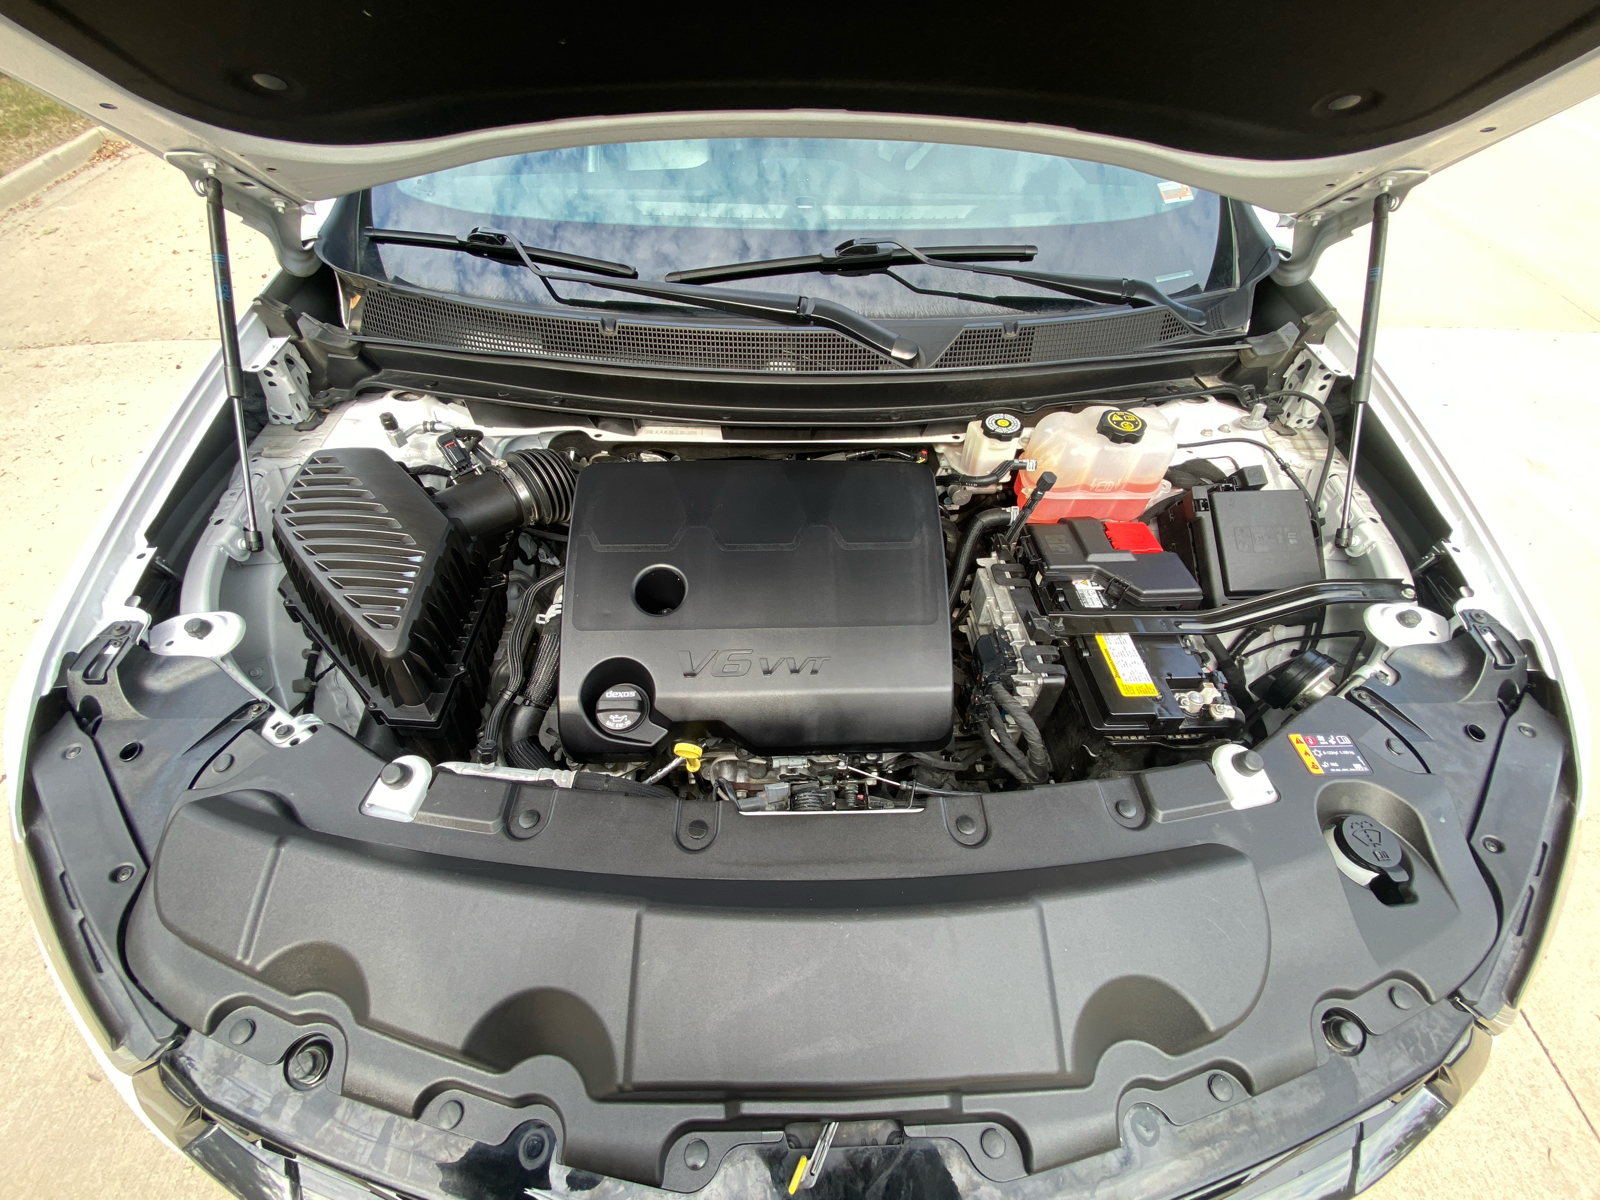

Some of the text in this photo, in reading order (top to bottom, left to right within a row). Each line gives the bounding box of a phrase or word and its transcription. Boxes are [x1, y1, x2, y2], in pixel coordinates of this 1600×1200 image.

[678, 649, 831, 678] V6 VVT
[605, 690, 636, 698] dexos
